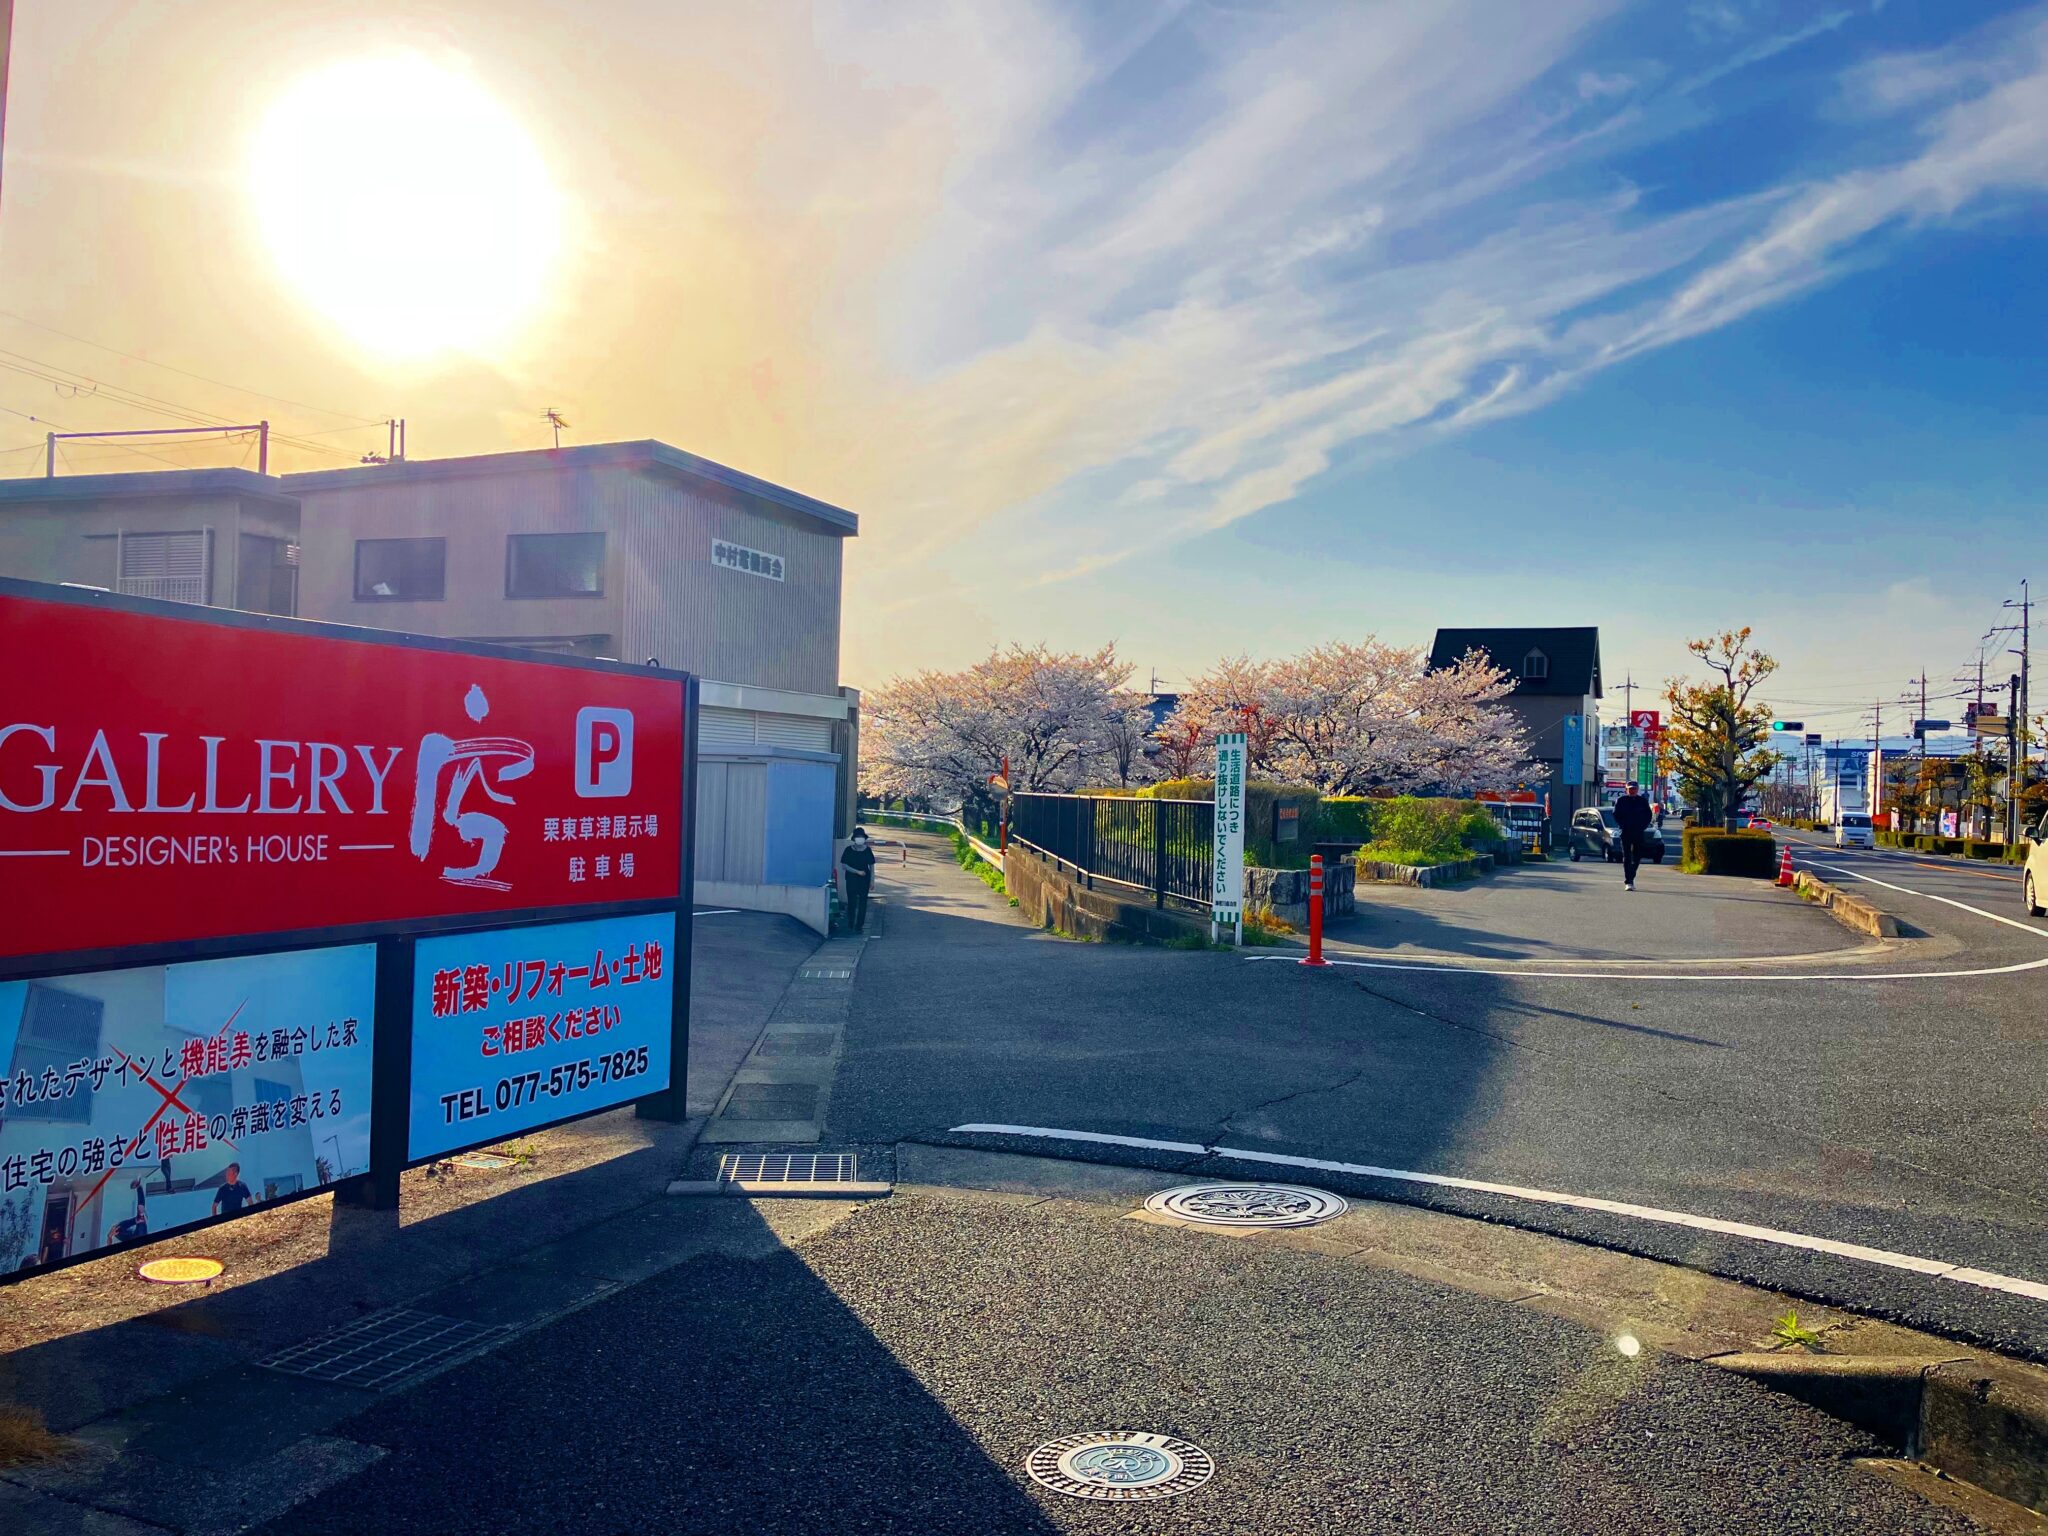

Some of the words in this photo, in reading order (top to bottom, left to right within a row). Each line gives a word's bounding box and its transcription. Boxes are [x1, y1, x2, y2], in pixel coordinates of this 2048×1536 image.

[0, 723, 404, 814] GALLERY
[590, 721, 621, 785] P
[1229, 749, 1241, 833] 生活道路につき
[83, 836, 238, 866] DESIGNER's
[247, 835, 328, 863] HOUSE
[543, 814, 658, 842] 栗東草津展示場
[1216, 750, 1228, 893] 通り抜けしないでください
[569, 853, 634, 882] 駐車場
[432, 941, 662, 1017] 新築・リフォーム・土地
[481, 1004, 621, 1056] ご相談ください
[441, 1088, 490, 1124] TEL
[495, 1046, 648, 1110] 077-575-7825
[2, 1089, 342, 1192] 住宅の強さと性能の常識を変える
